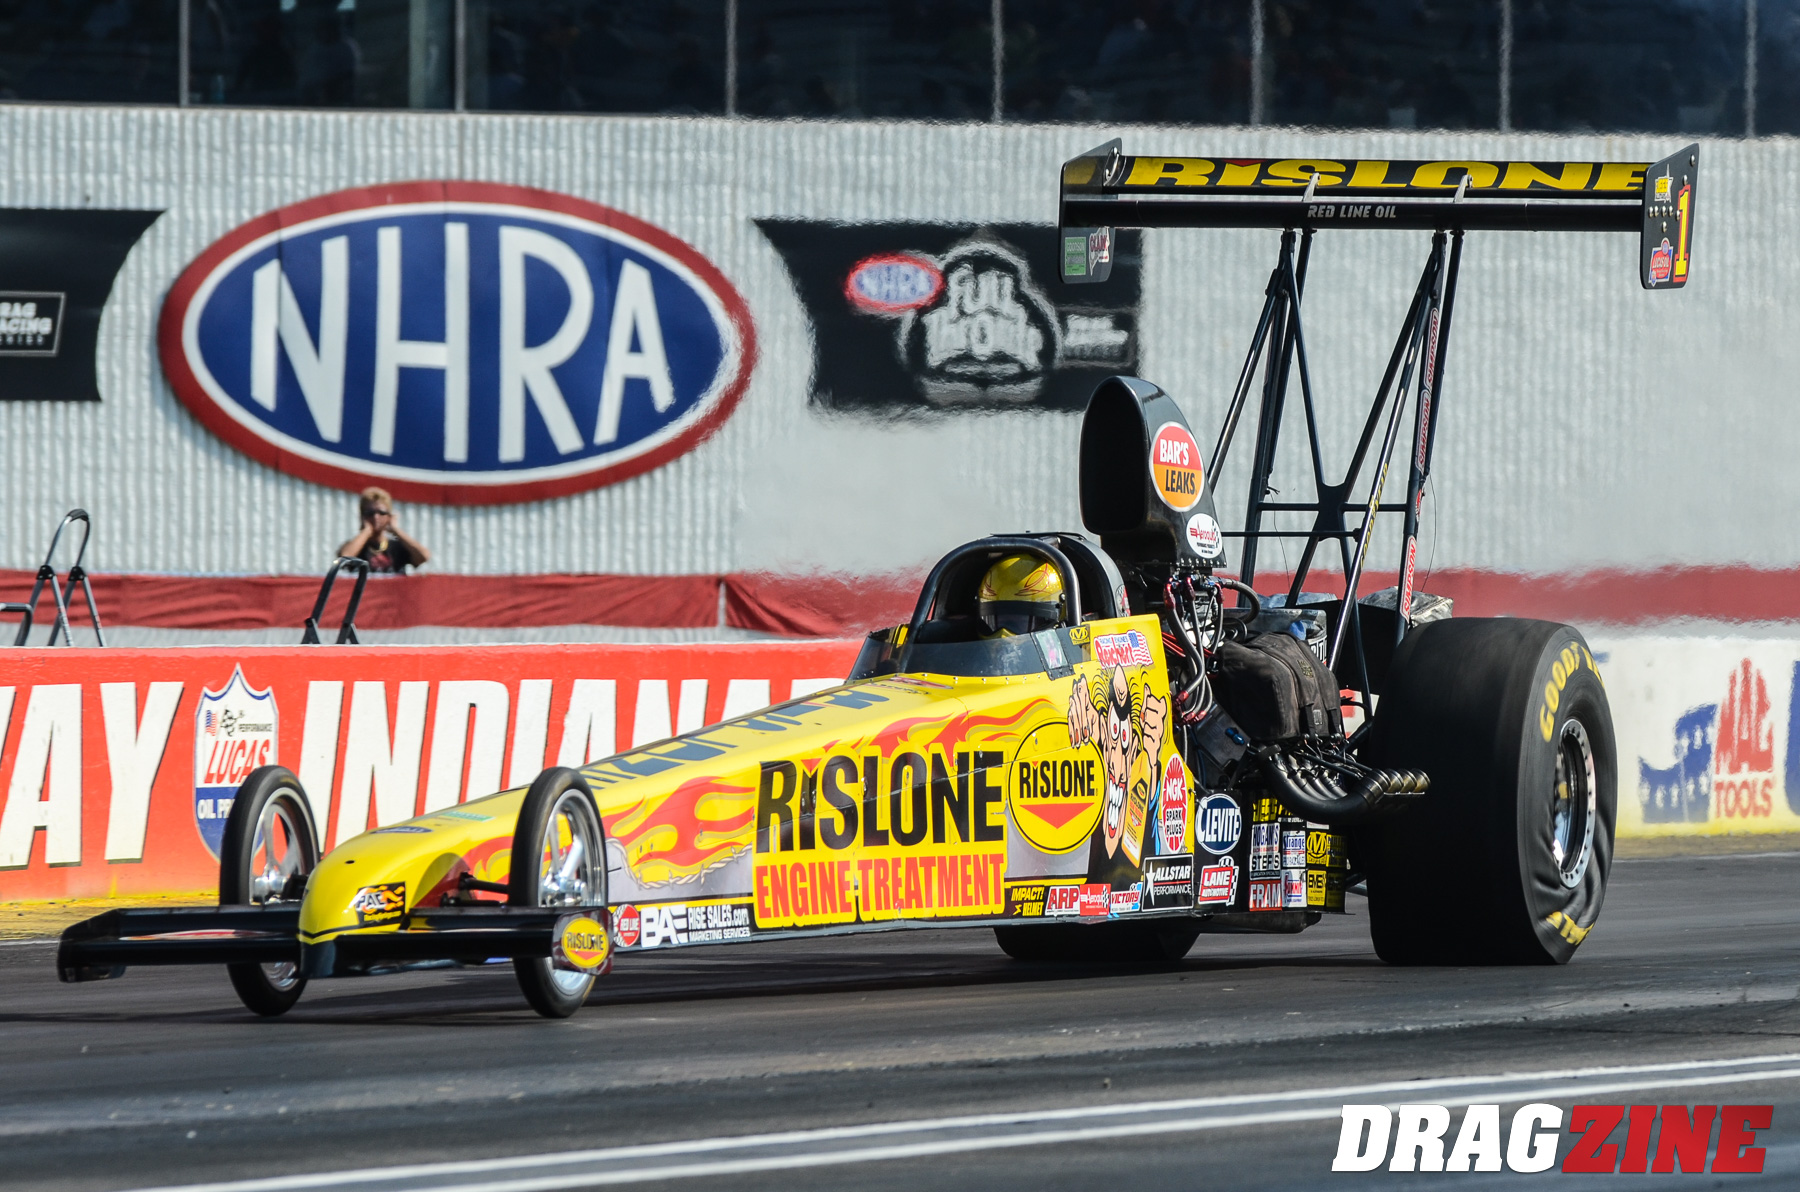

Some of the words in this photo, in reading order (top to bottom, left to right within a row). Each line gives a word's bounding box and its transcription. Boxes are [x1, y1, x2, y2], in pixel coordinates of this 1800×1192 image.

[1125, 157, 1647, 191] RISLONE
[1307, 204, 1336, 218] RED
[1339, 204, 1372, 218] LINE
[1374, 205, 1396, 218] OIL
[1674, 185, 1691, 282] 1
[250, 222, 676, 463] NHRA
[1159, 438, 1189, 466] BAR'S
[1165, 469, 1195, 495] LEAKS
[204, 739, 270, 784] LUCAS
[0, 681, 184, 869] AY
[1019, 760, 1096, 799] RISLONE
[755, 746, 1004, 853] RISLONE
[1166, 778, 1183, 802] NGK
[1714, 778, 1773, 818] TOOLS
[197, 799, 216, 819] OIL
[1166, 809, 1183, 822] SPARK
[1198, 797, 1240, 844] CLEVITE
[1166, 825, 1182, 837] PLUGS
[1154, 866, 1191, 881] ALLSTAR
[1204, 871, 1229, 886] LANE
[755, 860, 851, 918] ENGINE
[858, 854, 1005, 911] TREATMENT
[1011, 887, 1045, 901] IMPACT!
[1111, 891, 1140, 904] VICTORY
[1154, 884, 1191, 896] PERFORMANCE
[1202, 887, 1229, 898] AUTOMOTIVE
[1250, 883, 1281, 909] FRAM
[1022, 902, 1044, 916] HELMET
[1047, 887, 1080, 910] ARP
[620, 918, 629, 931] RED
[629, 917, 639, 931] LINE
[688, 906, 706, 930] RISE
[707, 904, 750, 927] SALES.com
[566, 932, 604, 951] RISLONE
[688, 929, 722, 942] MARKETING
[723, 927, 750, 939] SERVICES
